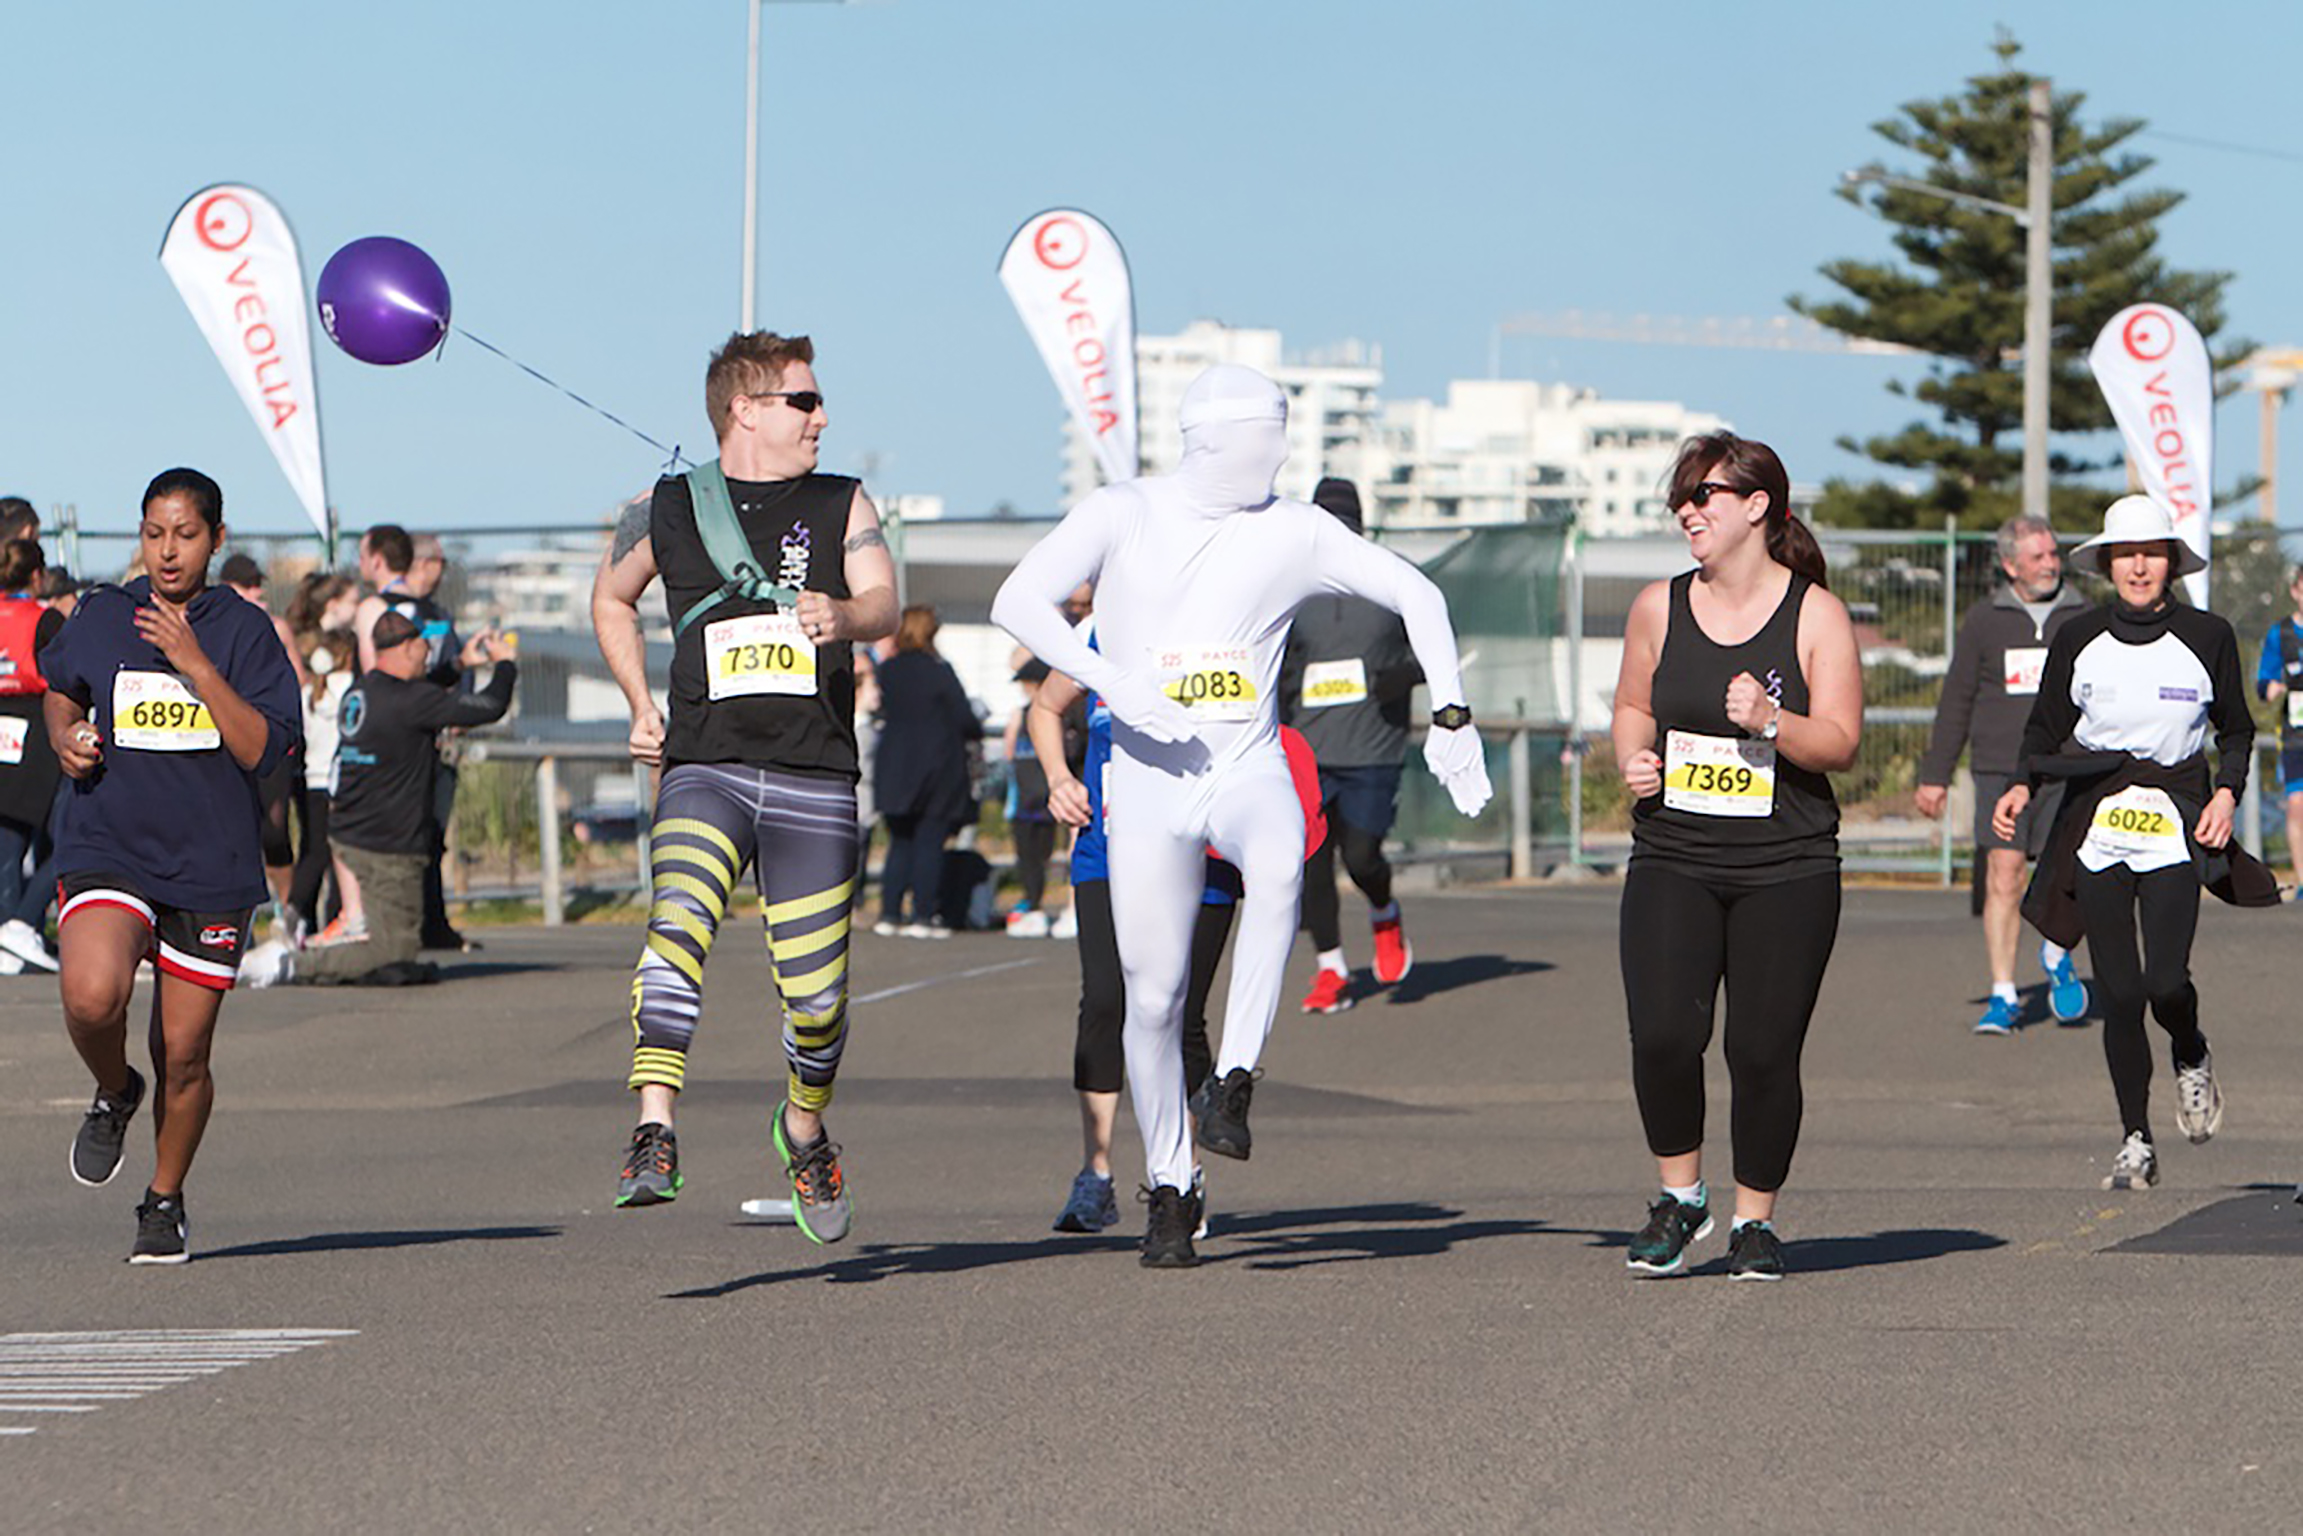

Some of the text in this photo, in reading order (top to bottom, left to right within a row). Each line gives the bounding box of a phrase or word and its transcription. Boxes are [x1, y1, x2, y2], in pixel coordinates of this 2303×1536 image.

[225, 255, 298, 429] VEOLIA
[1059, 278, 1120, 434] VEOLIA
[2144, 370, 2197, 523] VEOLIA
[726, 643, 795, 672] 7370
[1178, 671, 1242, 700] 7083
[133, 700, 201, 728] 6897
[1684, 762, 1752, 793] 7369
[2108, 807, 2164, 833] 6022
